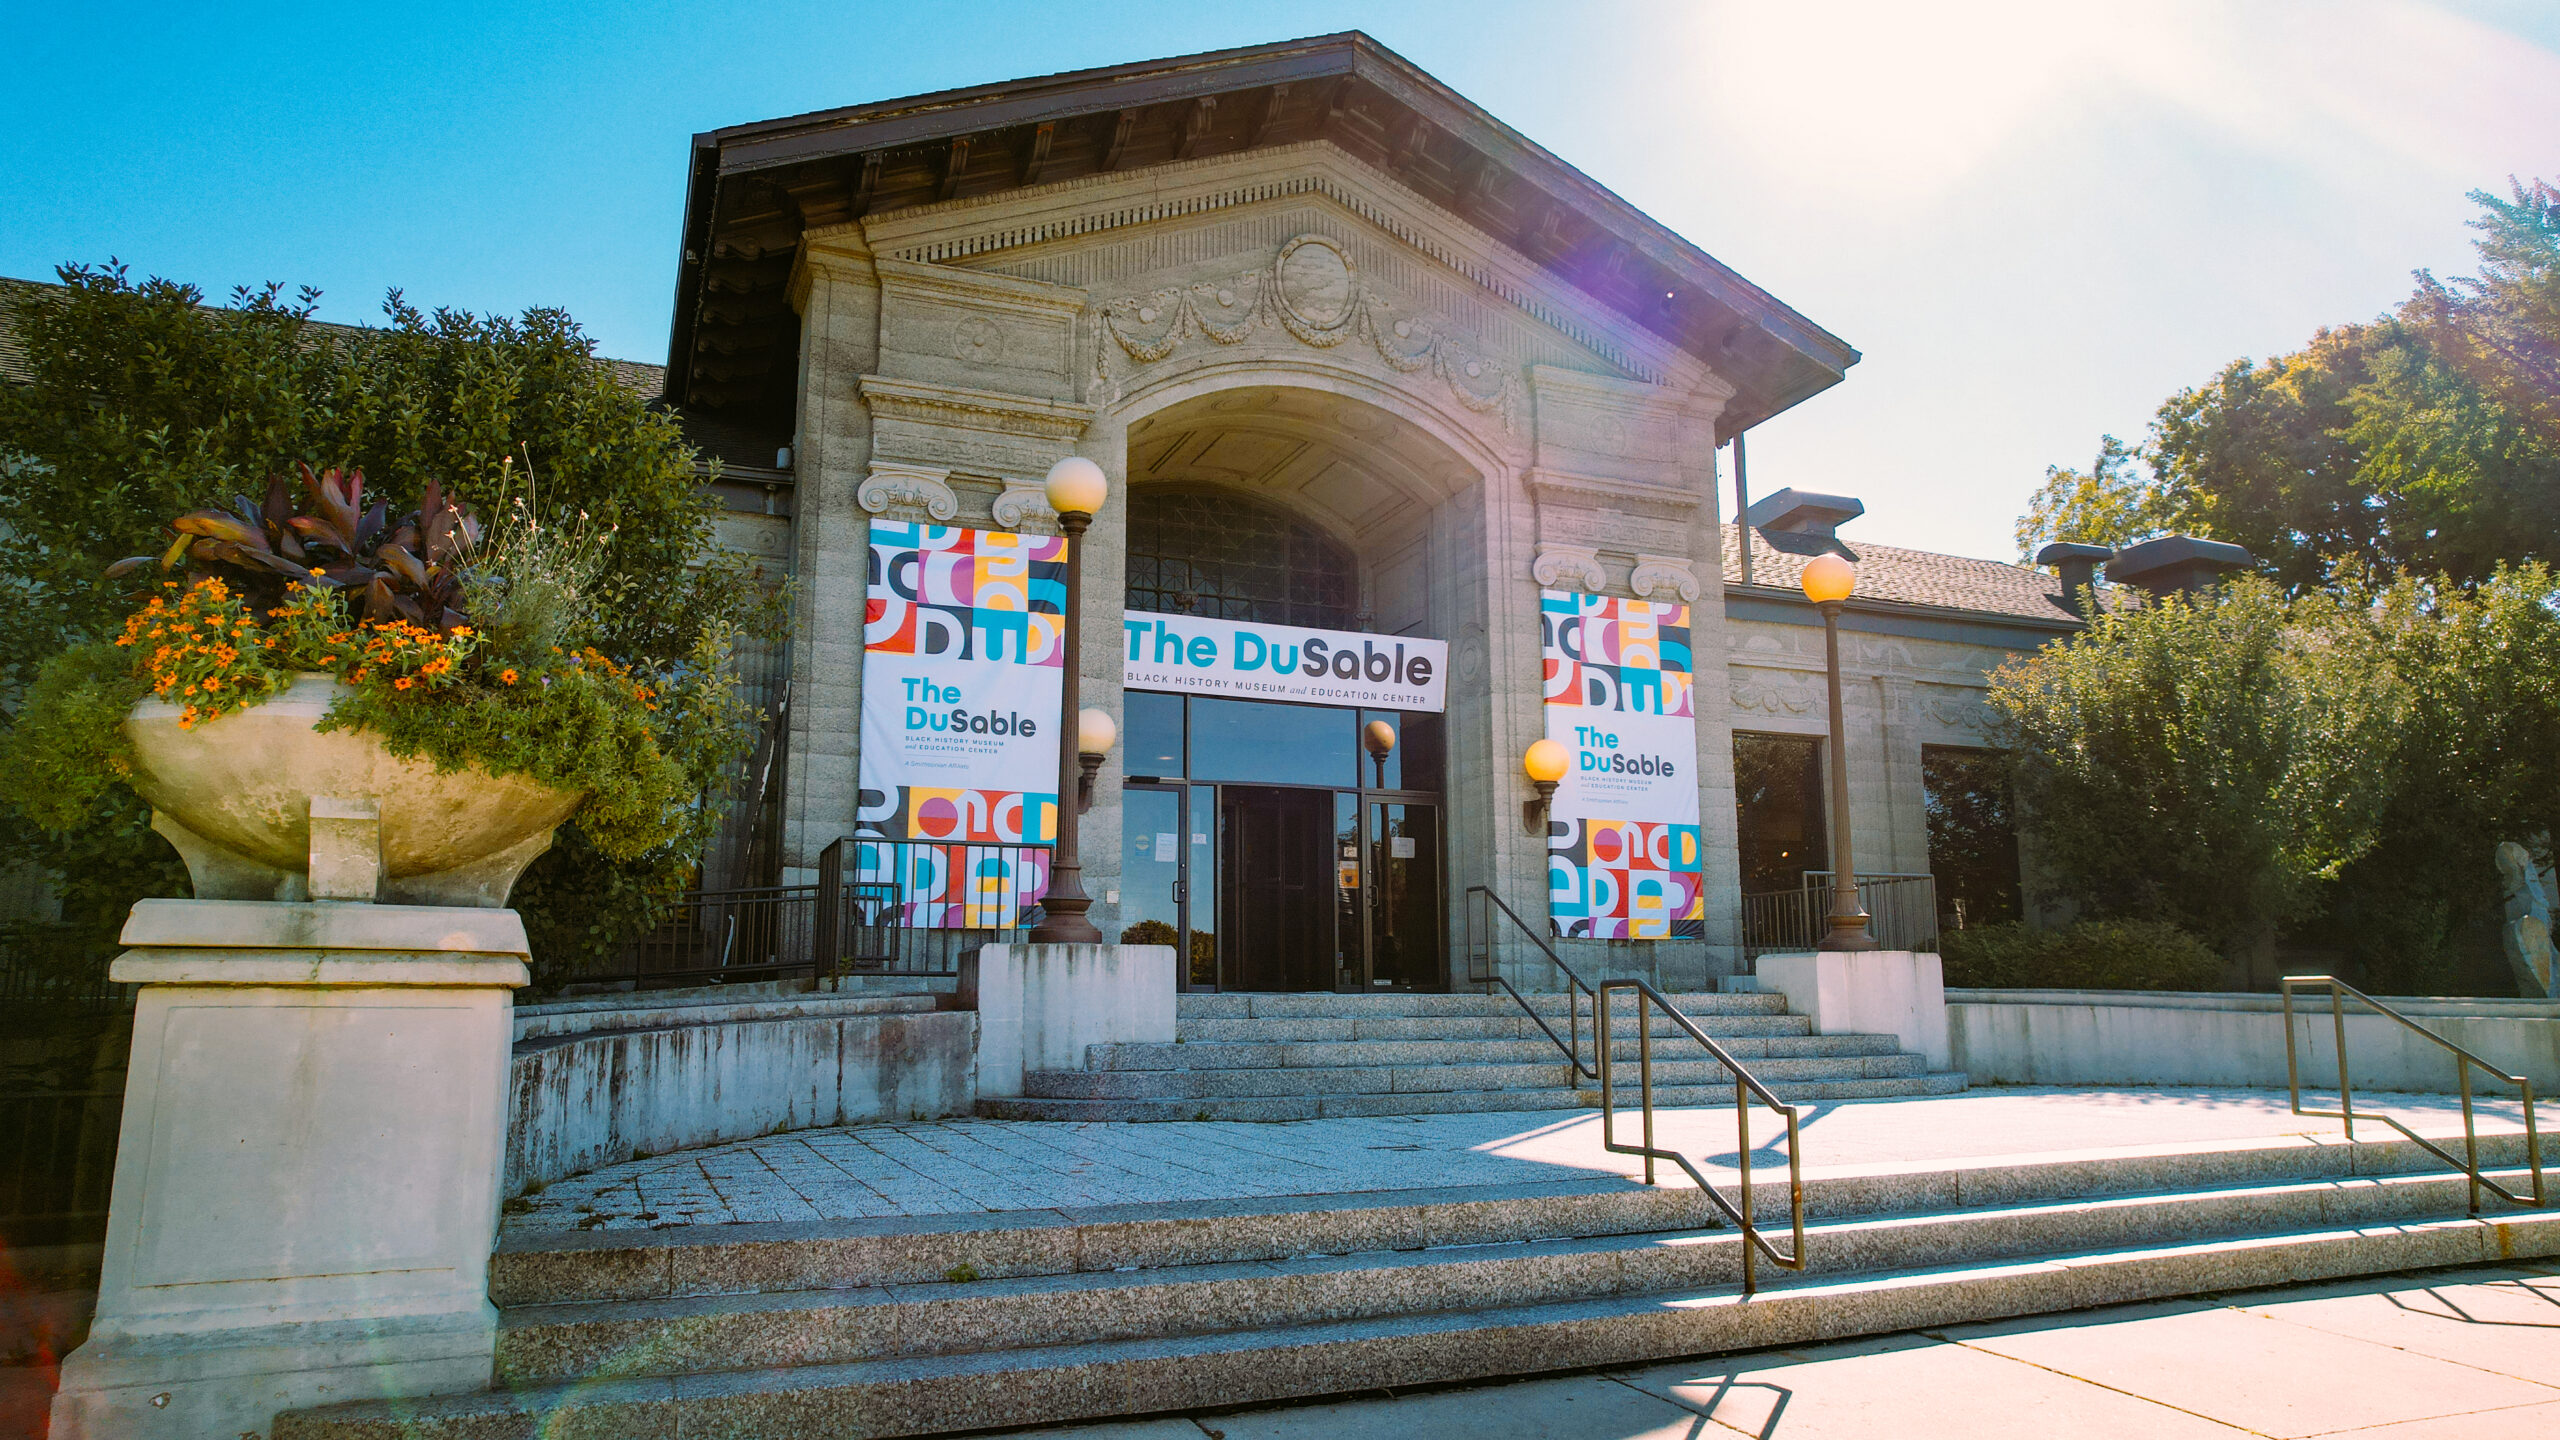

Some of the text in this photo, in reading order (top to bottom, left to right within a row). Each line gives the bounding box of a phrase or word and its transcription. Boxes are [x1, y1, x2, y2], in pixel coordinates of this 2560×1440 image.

[1124, 620, 1433, 686] The DuSable
[901, 677, 962, 704] The
[1127, 672, 1426, 704] BLACK HISTORY MUSEUM and EDUCATION CENTER
[905, 706, 1037, 737] DuSable
[919, 744, 965, 752] EDUCATION
[1574, 725, 1619, 749] The
[1580, 751, 1675, 777] DuSable
